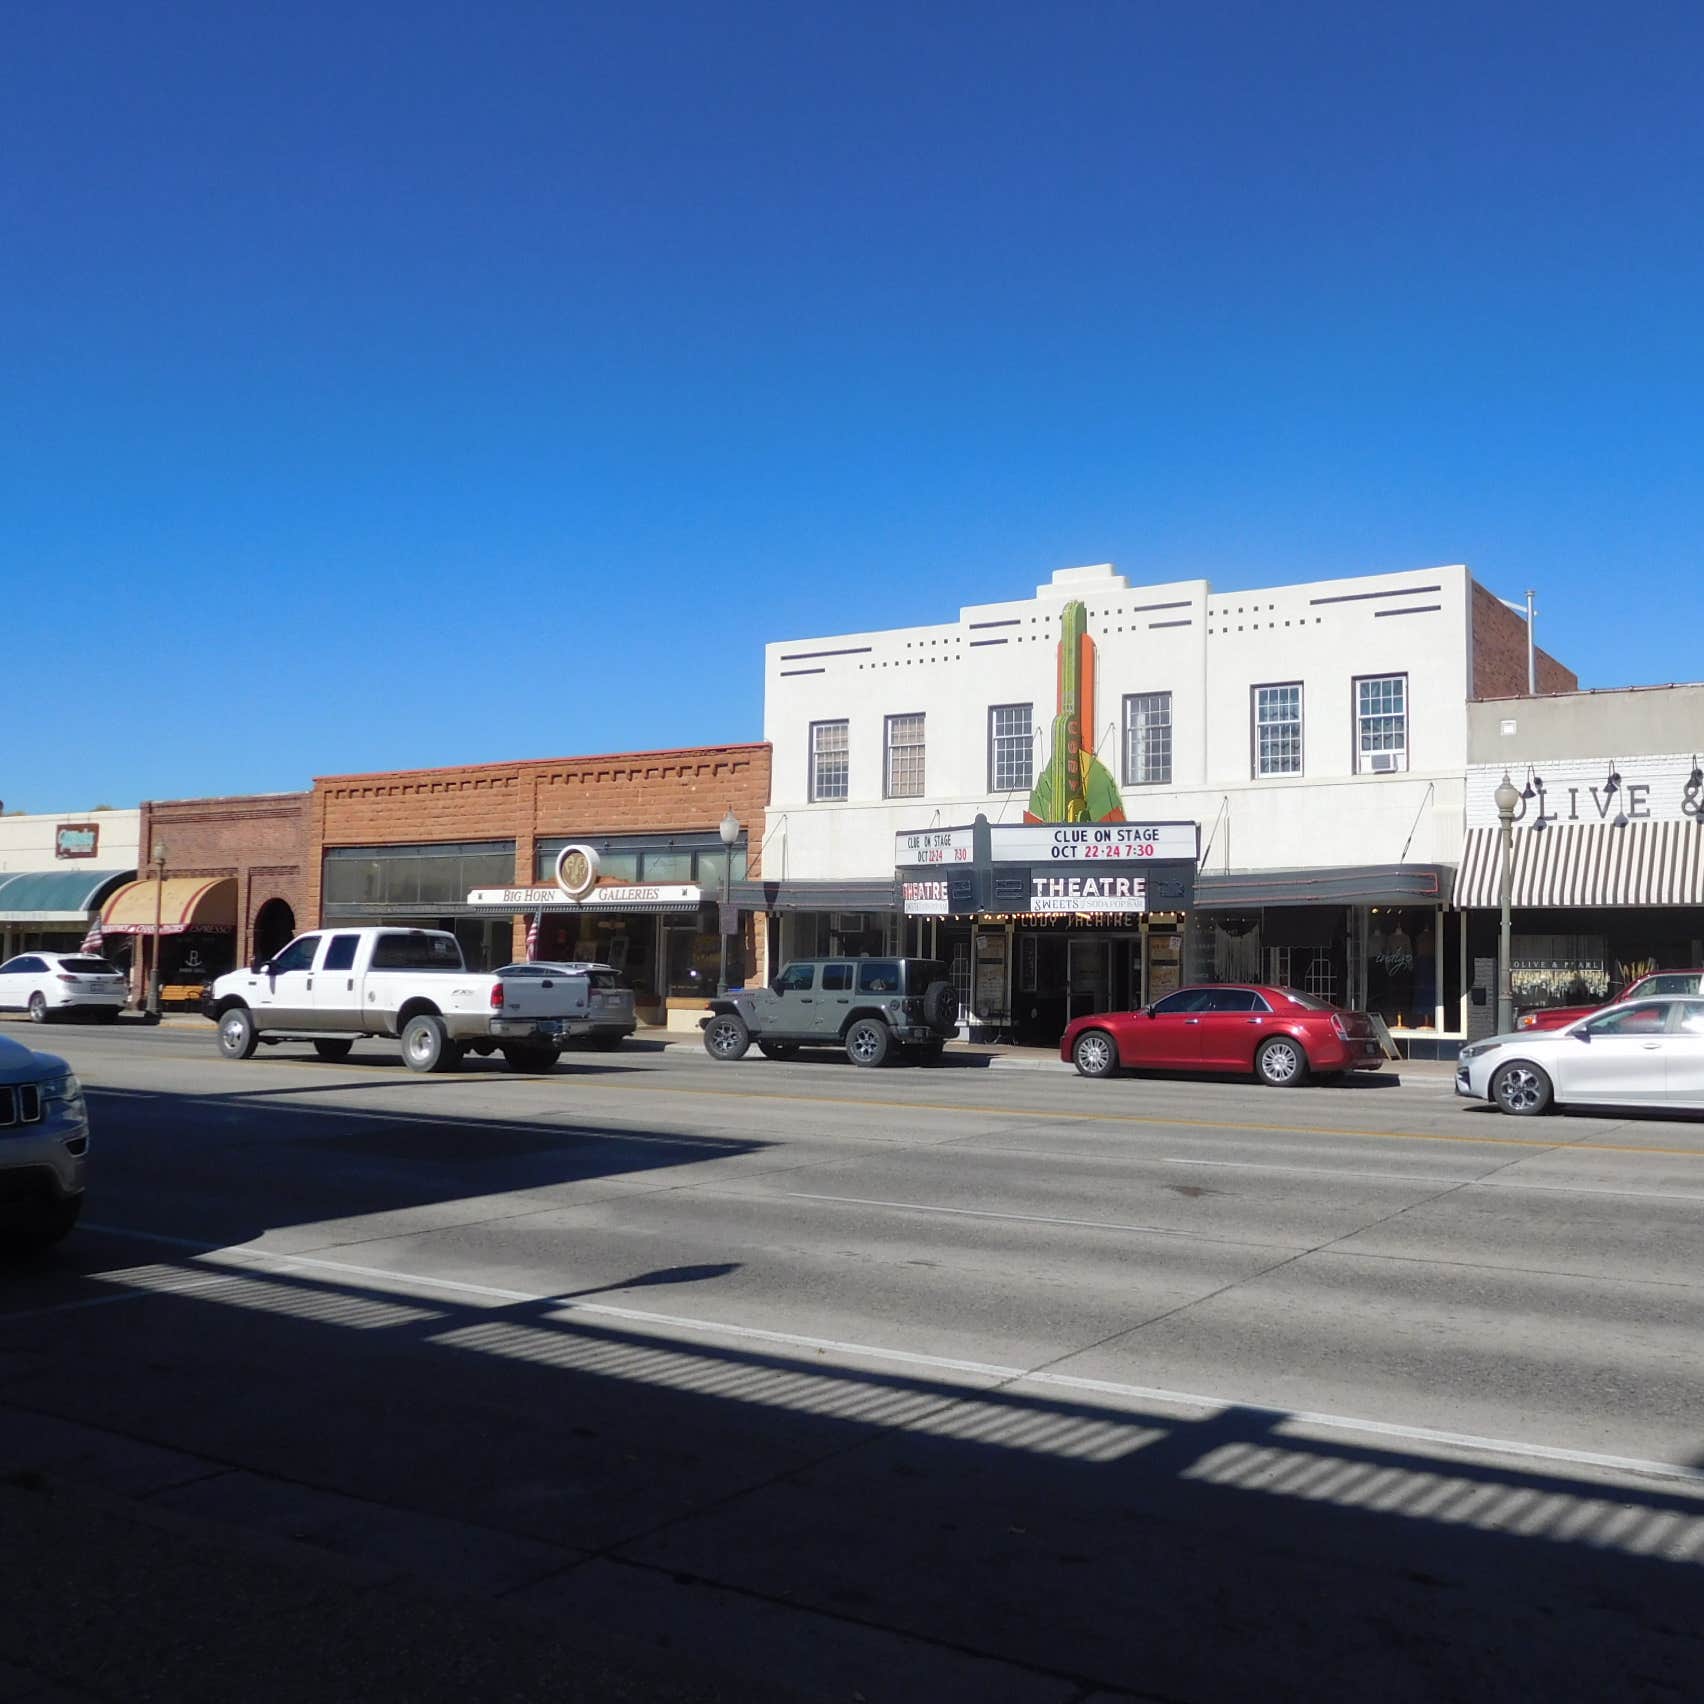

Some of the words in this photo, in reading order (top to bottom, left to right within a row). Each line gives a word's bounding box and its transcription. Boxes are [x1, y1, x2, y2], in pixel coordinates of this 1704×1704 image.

[1681, 780, 1704, 817] &
[908, 836, 920, 849] CLUE
[924, 835, 931, 848] ON
[934, 834, 952, 847] STAGE
[1054, 829, 1088, 843] CLUE
[1094, 829, 1111, 842] ON
[1117, 828, 1160, 842] STAGE
[918, 850, 928, 862] OCT
[1051, 845, 1078, 858] OCT
[1125, 844, 1154, 857] 7:30
[503, 889, 521, 902] BIG
[524, 888, 555, 901] HORN
[599, 887, 660, 901] GALLERIES
[903, 881, 948, 900] THEATRE
[1033, 877, 1145, 897] THEATRE
[1034, 899, 1079, 911] SWEETS
[1513, 961, 1545, 969] OLIVE
[1551, 961, 1558, 969] &
